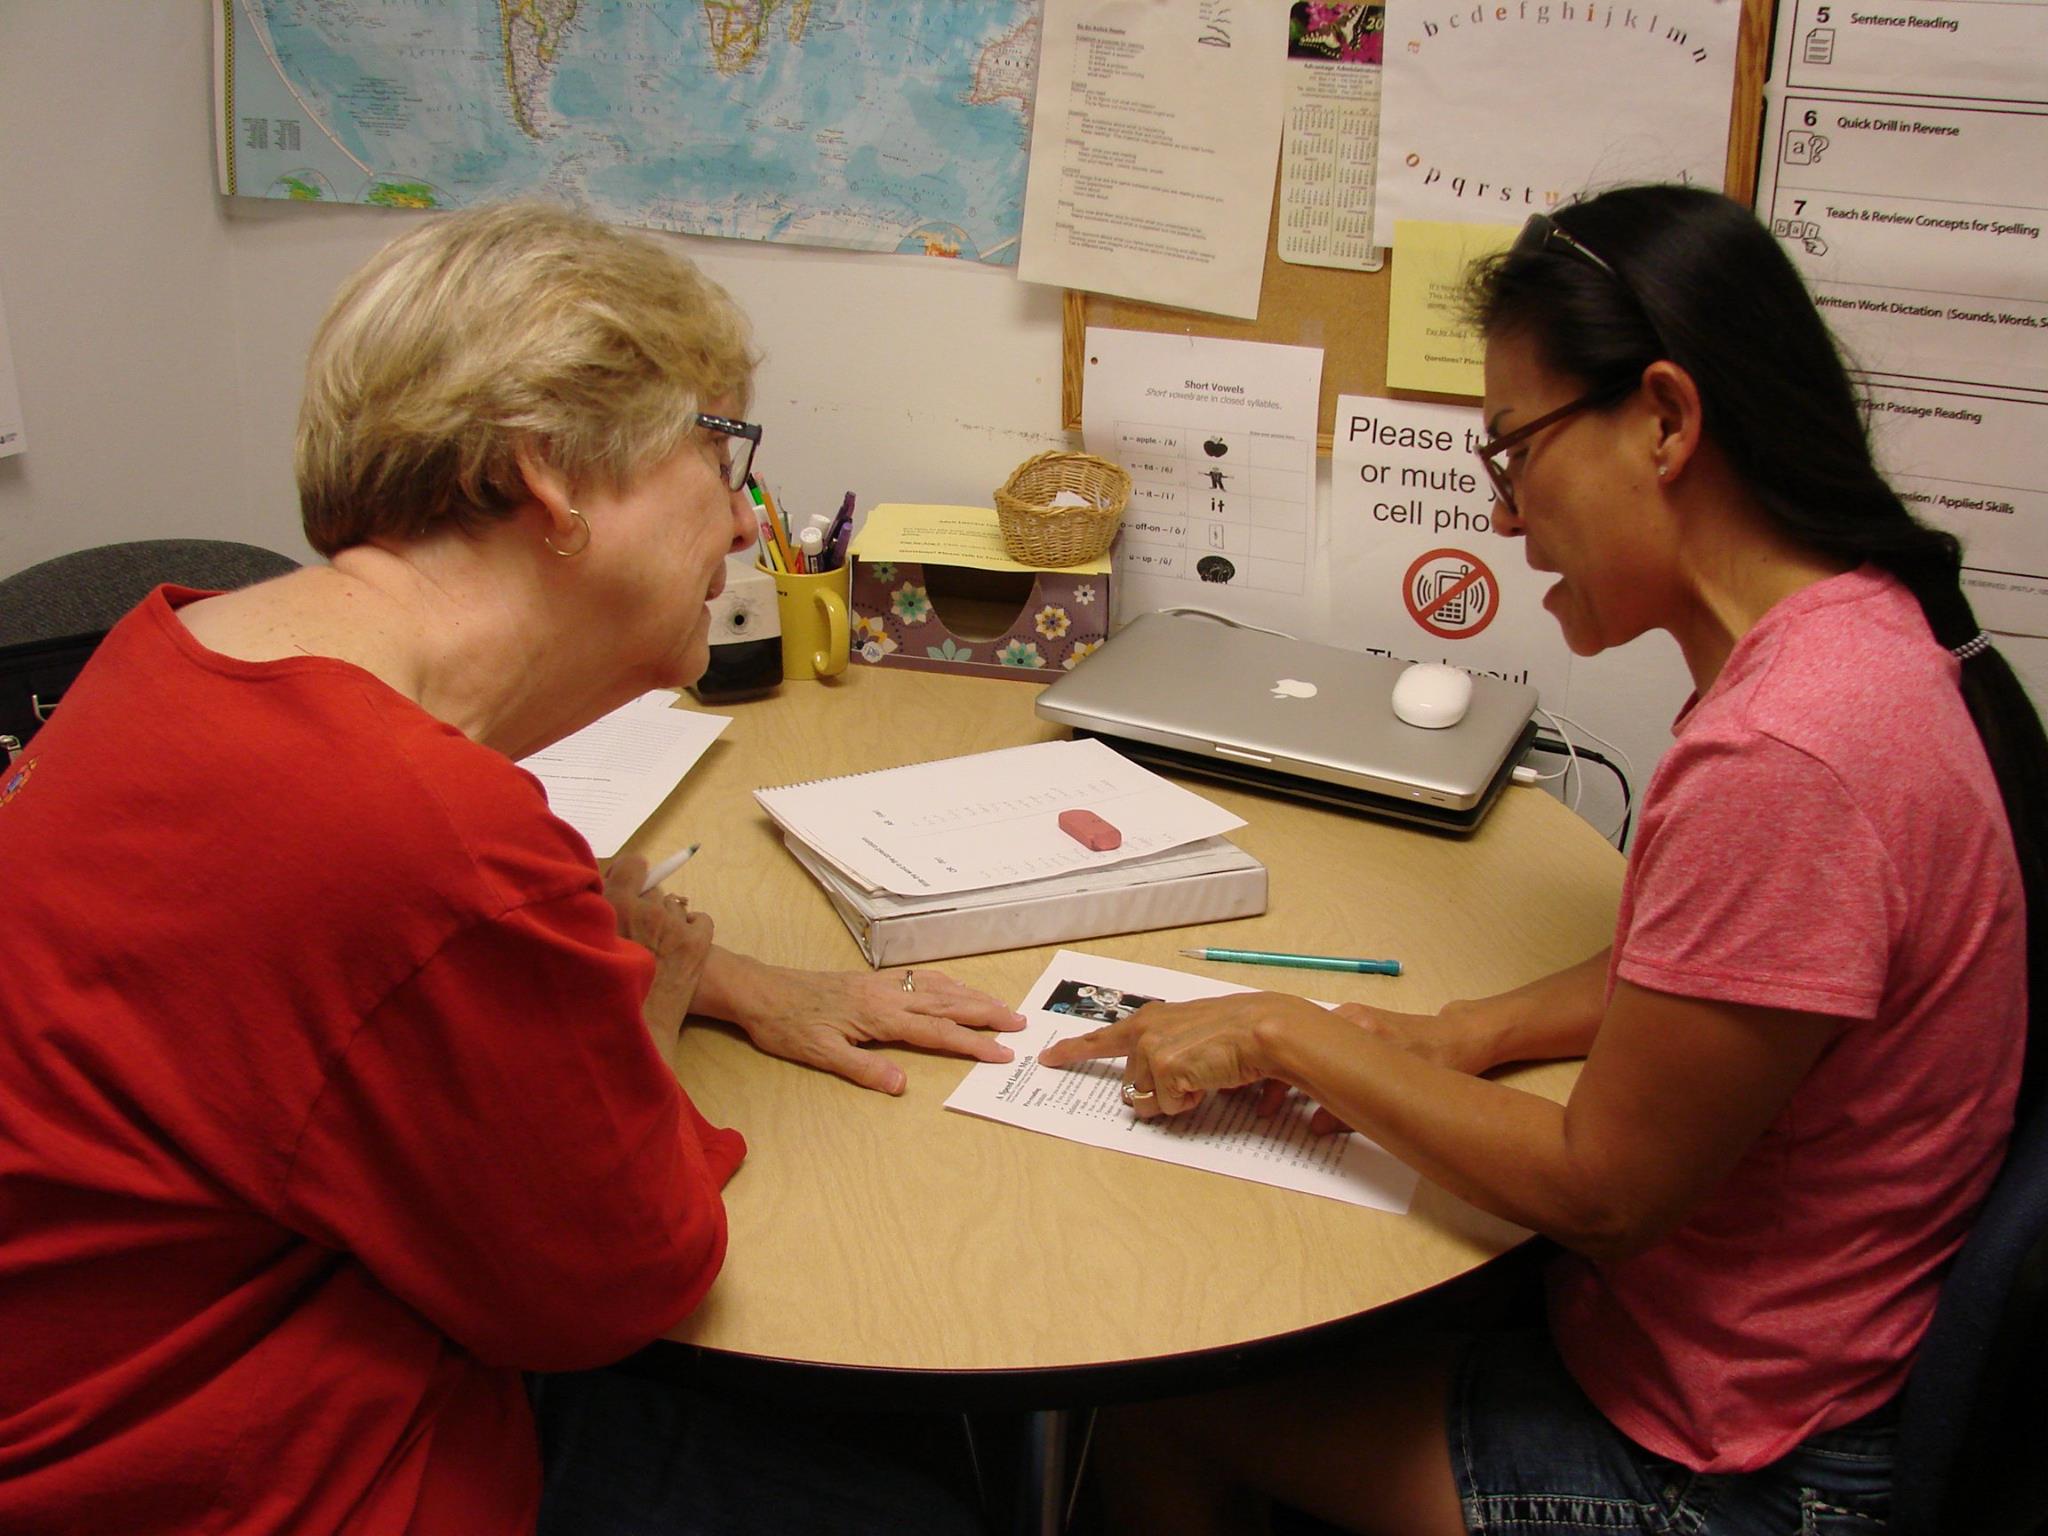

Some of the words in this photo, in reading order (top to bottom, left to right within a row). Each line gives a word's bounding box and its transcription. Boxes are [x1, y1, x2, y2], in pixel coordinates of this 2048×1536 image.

[1817, 7, 1830, 23] 5
[1850, 13, 1906, 27] Sentence
[1908, 17, 1959, 32] Reading
[1407, 41, 1420, 53] a
[1424, 20, 1438, 36] b
[1449, 14, 1460, 28] c
[1470, 5, 1483, 24] d
[1495, 7, 1507, 22] e
[1518, 1, 1529, 20] f
[1537, 5, 1550, 24] g
[1561, 1, 1575, 20] h
[1586, 3, 1595, 22] i
[1604, 4, 1613, 27] j
[1623, 9, 1638, 29] k
[1648, 15, 1657, 33] l
[1666, 26, 1688, 46] m
[1692, 47, 1707, 63] n
[1804, 110, 1817, 126] 6
[1837, 116, 1871, 130] Quick
[1873, 119, 1898, 132] Drill
[1900, 122, 1911, 133] in
[1913, 122, 1960, 136] Reverse
[1406, 153, 1420, 167] o
[1424, 167, 1441, 185] p
[1451, 174, 1466, 197] q
[1477, 180, 1491, 197] r
[1499, 184, 1513, 201] s
[1523, 185, 1534, 204] t
[1545, 190, 1559, 206] u
[1794, 200, 1807, 216] 7
[1826, 207, 1859, 220] Teach
[1861, 210, 1870, 220] &
[1872, 211, 1914, 225] Review
[1916, 215, 1969, 231] Concepts
[1971, 219, 1989, 231] for
[1990, 221, 2040, 239] Spelling
[1814, 295, 1856, 309] Written
[1858, 299, 1888, 312] Work
[1890, 303, 1942, 318] Dictation
[1998, 313, 2038, 328] Words,
[1184, 380, 1209, 391] Short
[1211, 383, 1245, 394] Vowels
[1145, 387, 1168, 397] Short
[1169, 391, 1195, 401] vowels
[1195, 394, 1209, 402] are
[1211, 394, 1218, 403] in
[1220, 395, 1245, 406] closed
[1247, 398, 1283, 410] syllables.
[1887, 402, 1932, 418] Passage
[1935, 407, 1982, 424] Reading
[1136, 437, 1157, 445] apple
[1349, 416, 1453, 452] Please
[1361, 464, 1390, 483] or
[1401, 467, 1476, 493] mute
[1146, 490, 1152, 498] it
[1210, 497, 1225, 513] it
[1939, 496, 1984, 510] Applied
[1985, 502, 2015, 514] Skills
[1373, 500, 1422, 525] cell
[1434, 505, 1496, 534] pho
[1135, 523, 1161, 532] off-on
